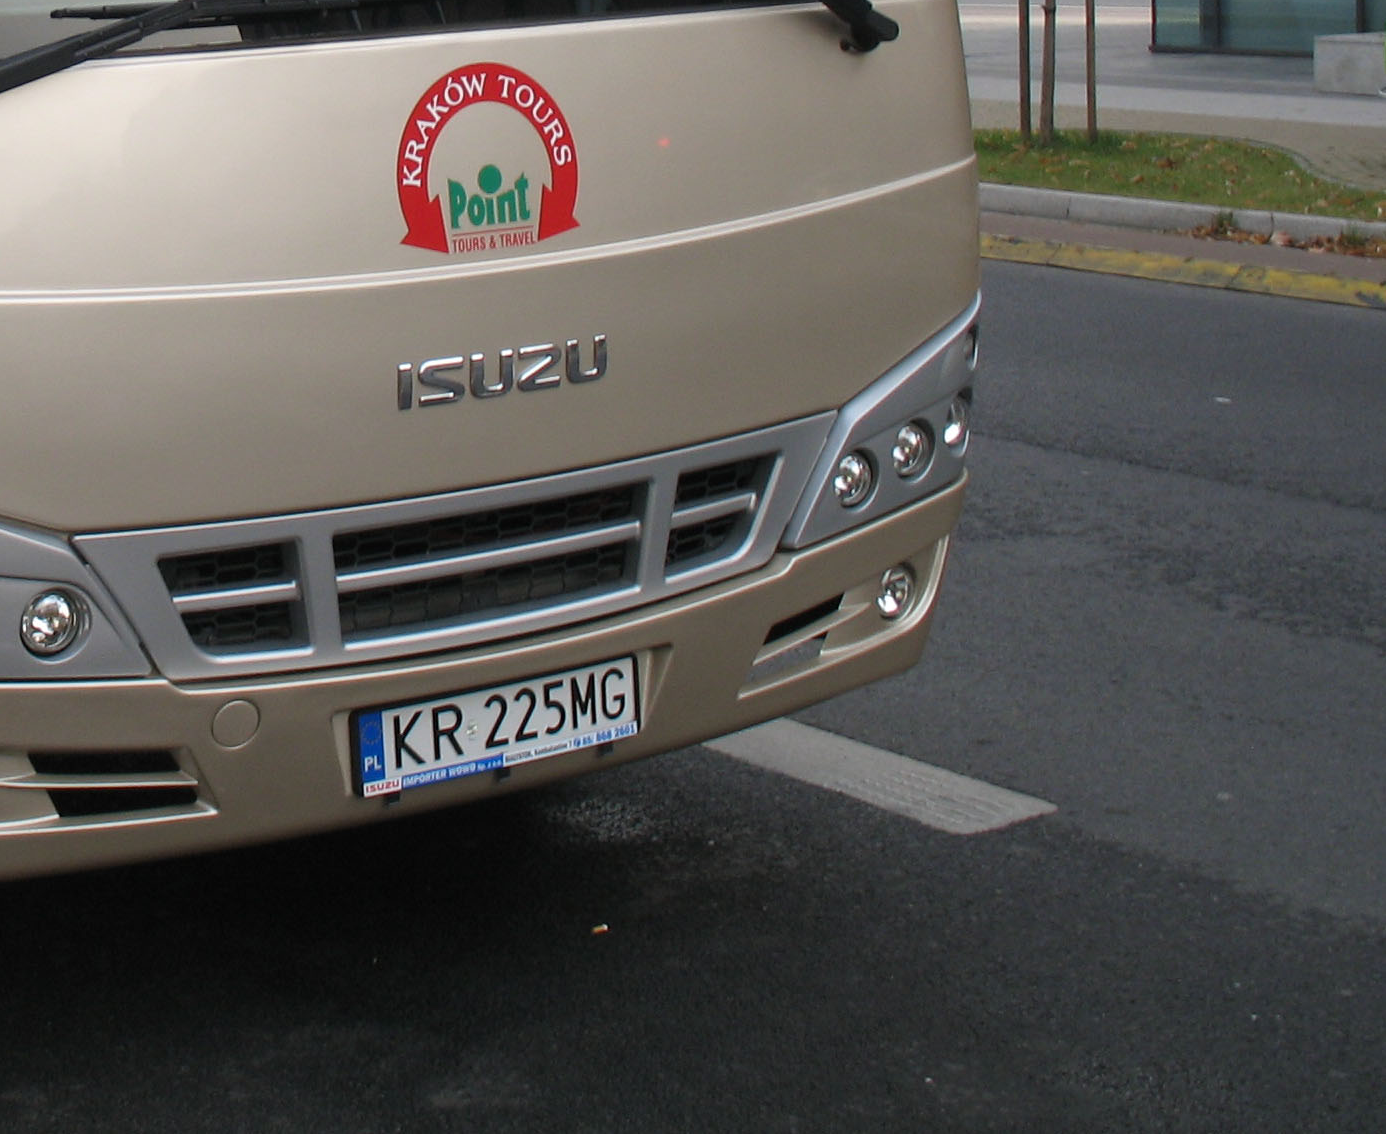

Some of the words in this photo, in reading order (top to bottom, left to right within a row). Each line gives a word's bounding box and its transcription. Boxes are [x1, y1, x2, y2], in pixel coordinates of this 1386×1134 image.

[402, 72, 487, 187] KRAKÓW
[497, 74, 573, 166] TOURS
[447, 164, 531, 229] Point
[452, 237, 487, 253] TOURS
[489, 235, 496, 250] &
[499, 230, 536, 248] TRAVEL
[397, 333, 608, 411] ISUZU
[393, 702, 464, 769] KR
[483, 667, 627, 750] 225MG
[364, 755, 382, 773] PL
[365, 778, 400, 794] ISUZU
